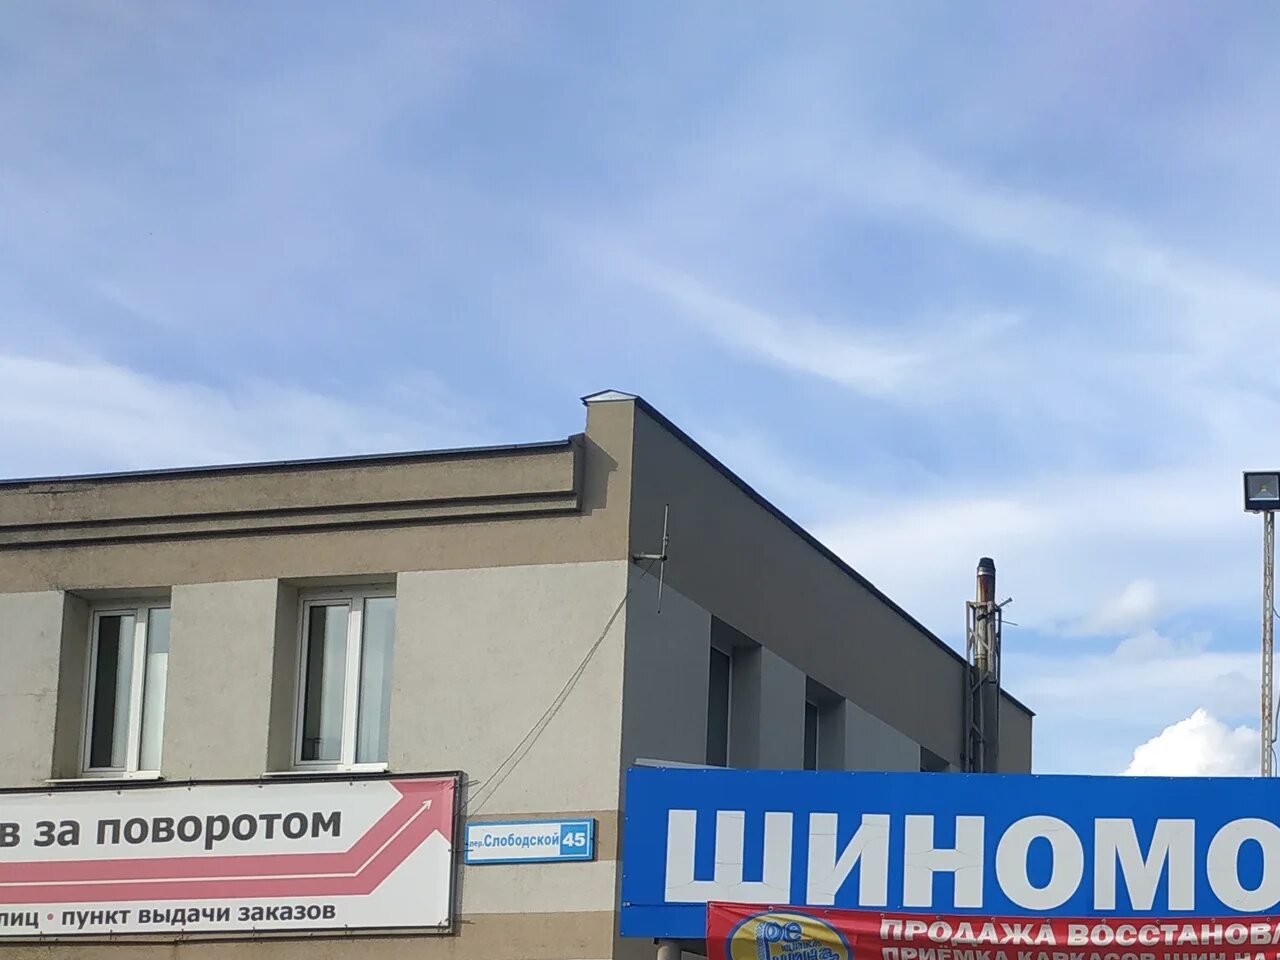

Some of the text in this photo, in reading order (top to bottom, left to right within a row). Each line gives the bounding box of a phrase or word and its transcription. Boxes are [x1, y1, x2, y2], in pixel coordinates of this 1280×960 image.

[34, 820, 80, 847] за
[97, 811, 341, 850] поворотом
[562, 832, 586, 847] 45
[62, 910, 131, 929] пункт
[138, 907, 230, 926] выдачи
[237, 904, 336, 921] заказов
[880, 919, 1057, 946] ПРОДАЖА
